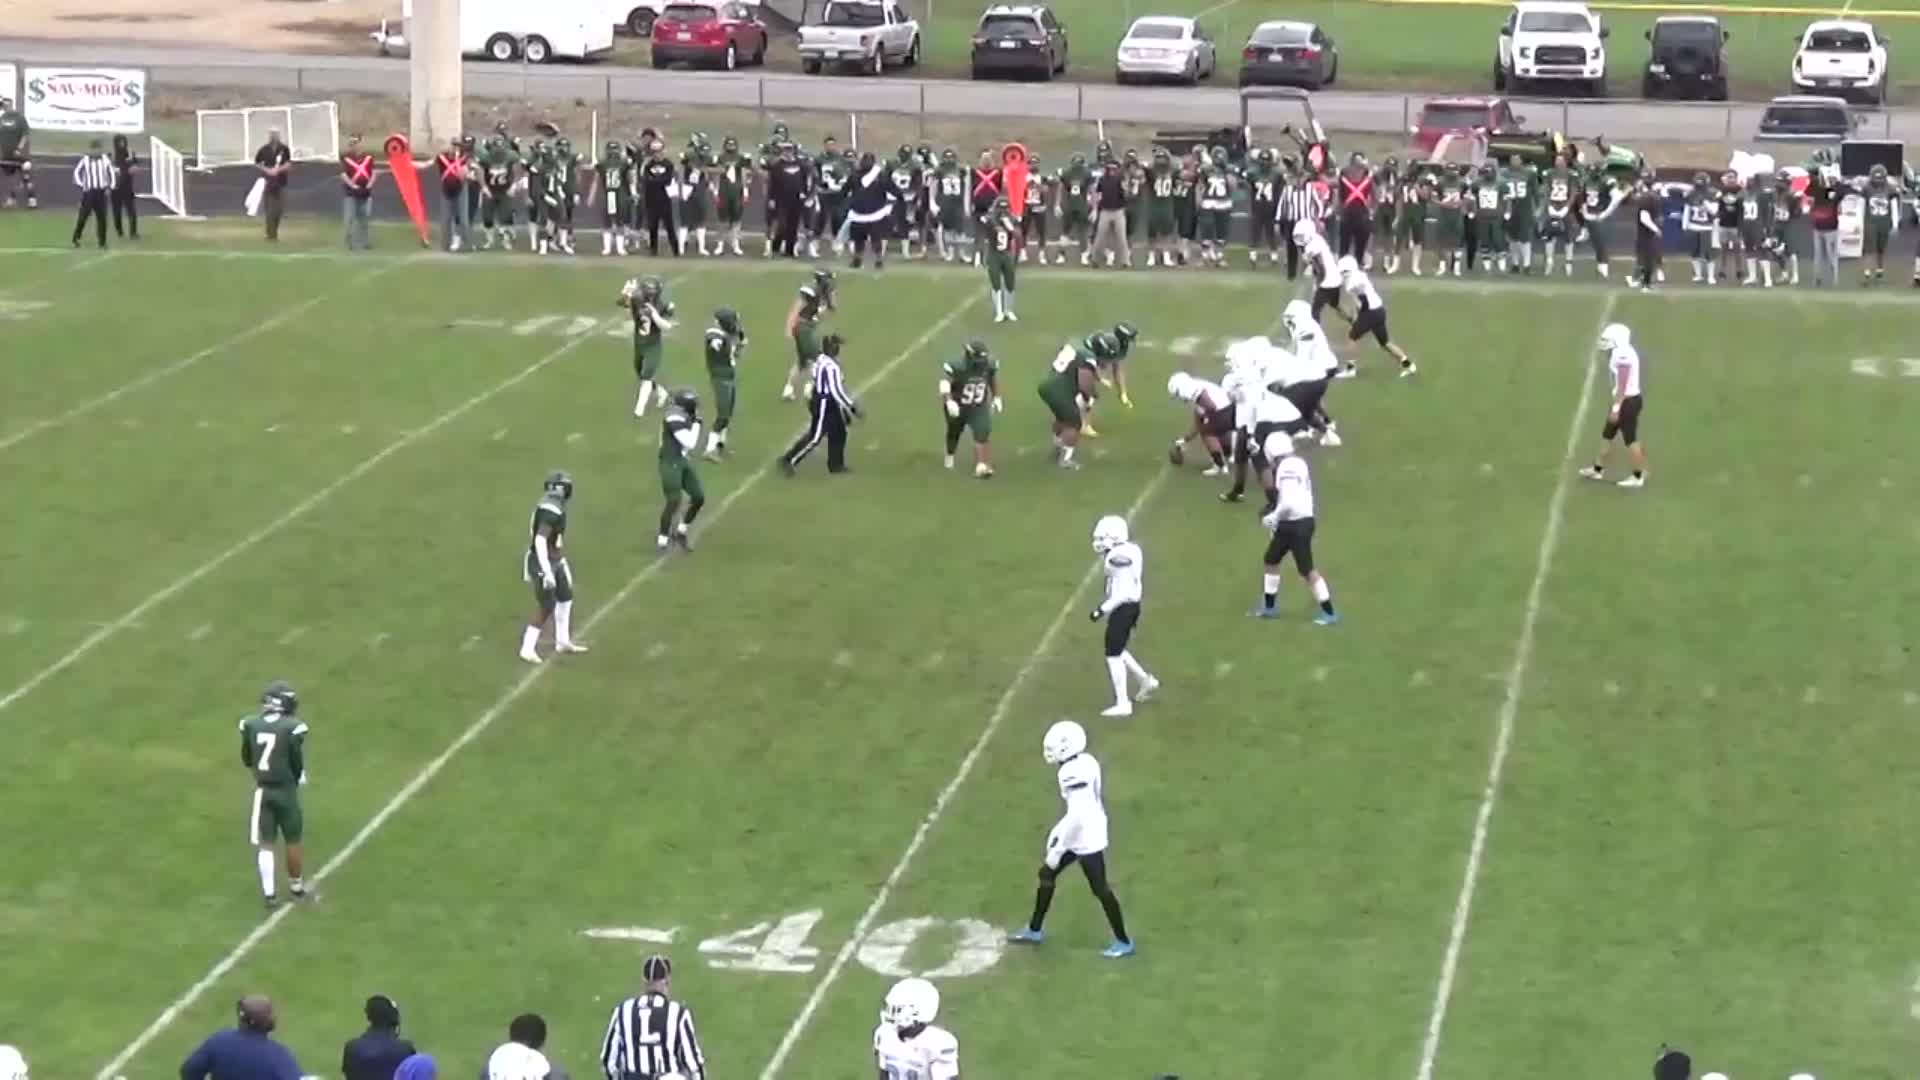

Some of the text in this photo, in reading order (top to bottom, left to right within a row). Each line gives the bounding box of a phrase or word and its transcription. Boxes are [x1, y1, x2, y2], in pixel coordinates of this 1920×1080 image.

[997, 231, 1008, 250] 9
[961, 383, 987, 405] 99
[256, 732, 277, 771] 7
[699, 908, 1007, 978] 40
[639, 1008, 662, 1044] L
